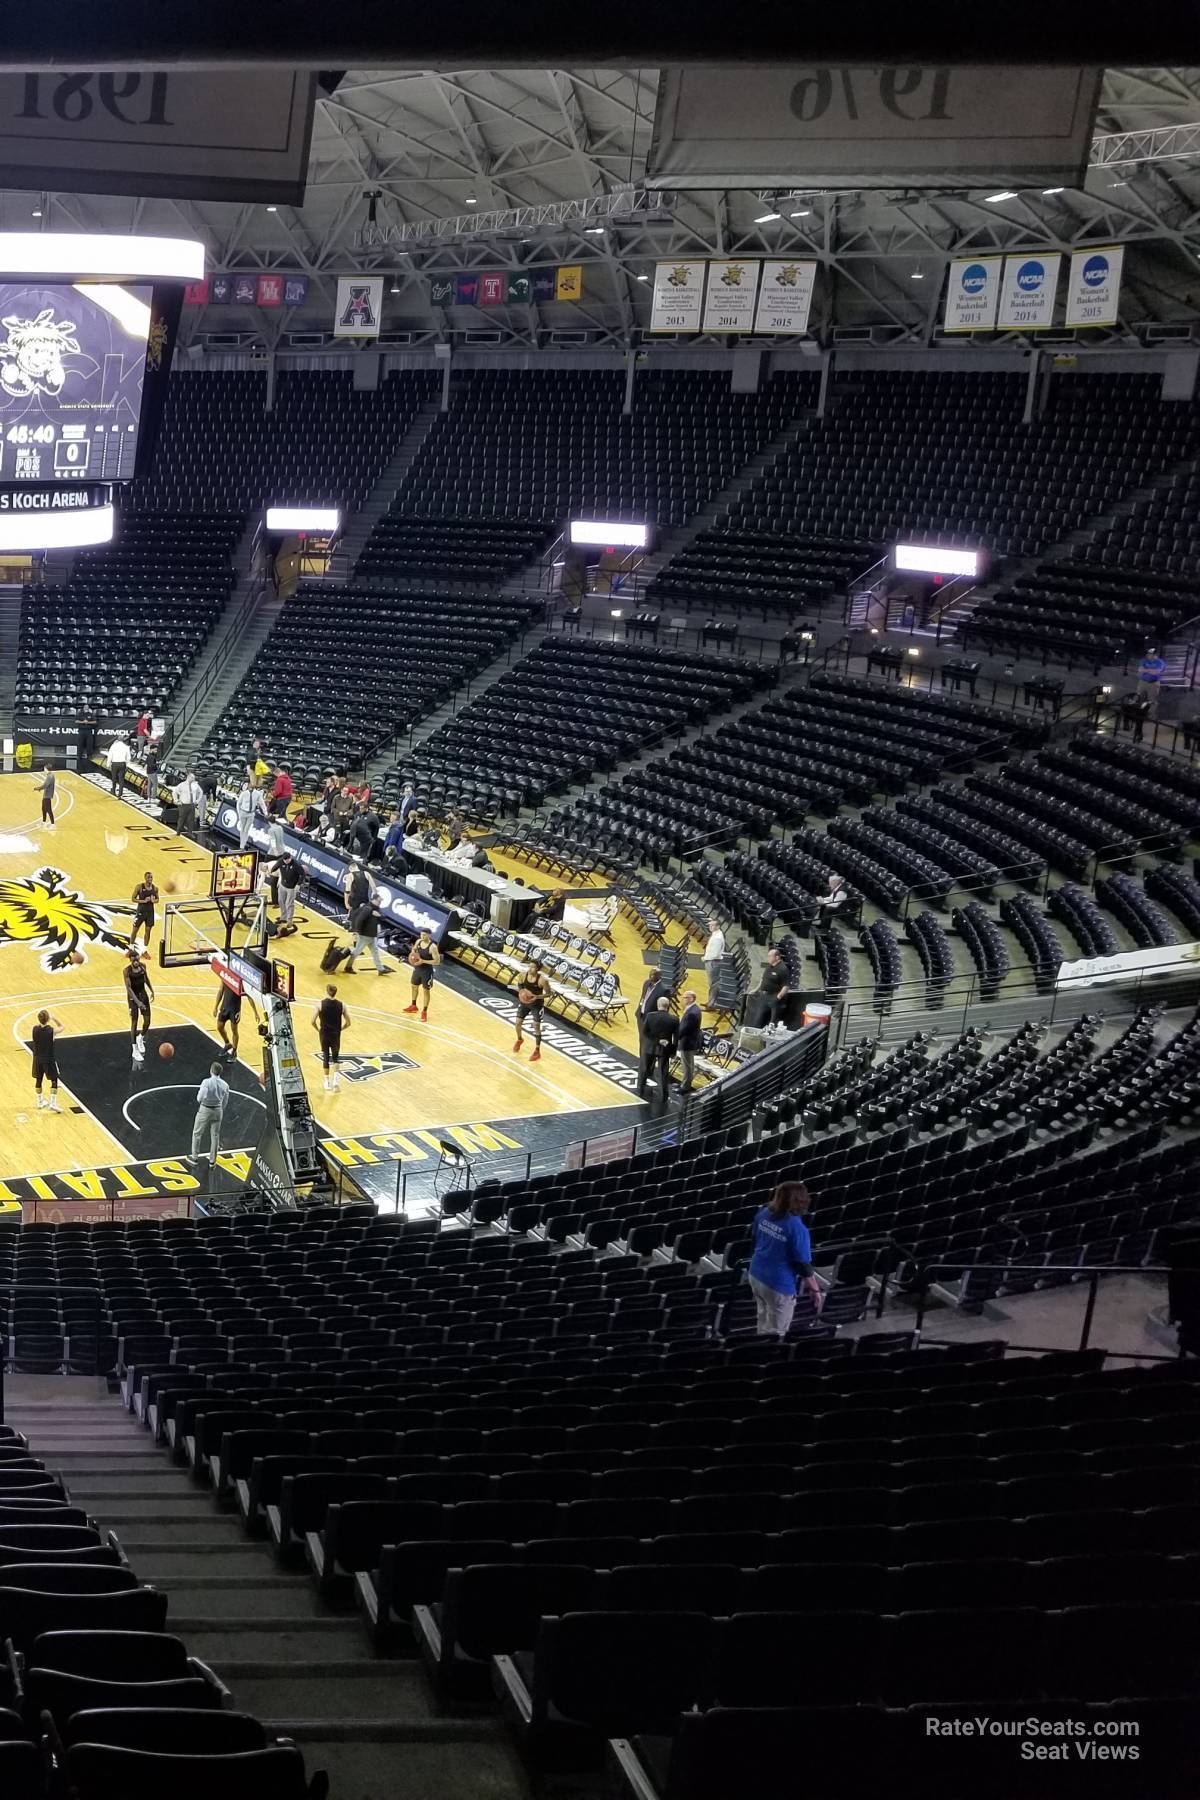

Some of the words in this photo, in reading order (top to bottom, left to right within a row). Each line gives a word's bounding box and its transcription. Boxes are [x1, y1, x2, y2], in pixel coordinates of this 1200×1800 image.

[1013, 291, 1044, 299] Women's
[1080, 287, 1109, 295] Women's
[1010, 300, 1044, 308] Basketball
[1076, 295, 1109, 304] Basketball
[956, 302, 988, 310] Basketball
[1013, 312, 1037, 321] 2014
[1081, 307, 1102, 317] 2015
[666, 316, 685, 325] 2013
[718, 317, 738, 325] 2014
[771, 318, 792, 327] 2015
[960, 313, 981, 323] 2013
[66, 444, 79, 462] 0
[12, 493, 50, 509] KOCH
[51, 492, 89, 508] ARENA
